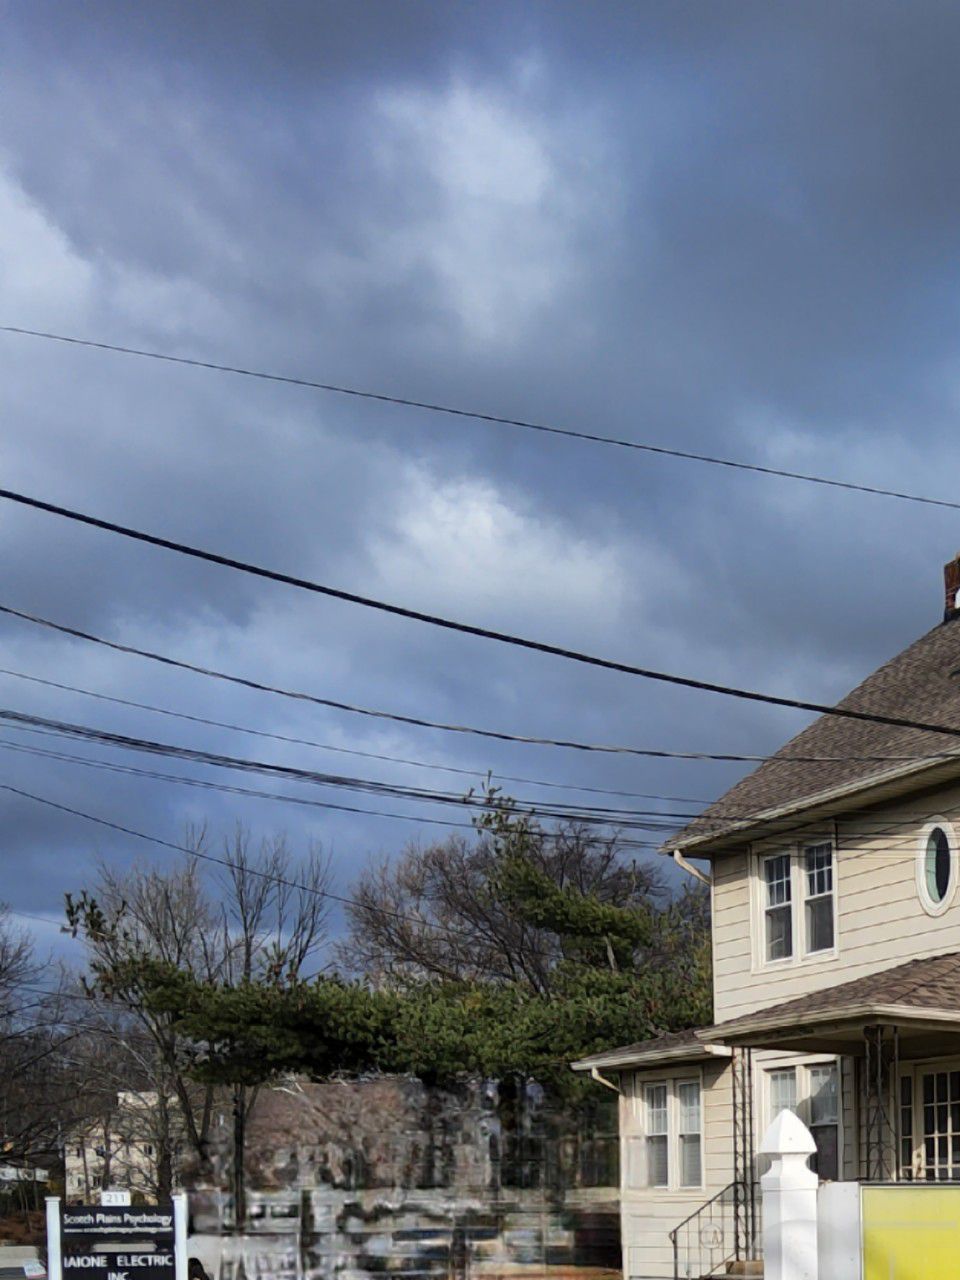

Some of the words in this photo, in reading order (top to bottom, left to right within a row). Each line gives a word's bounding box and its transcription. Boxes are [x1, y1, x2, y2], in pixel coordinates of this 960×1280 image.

[105, 1193, 125, 1203] 211
[64, 1213, 94, 1224] Scotch
[96, 1213, 122, 1224] Plains
[123, 1212, 172, 1226] Psychology
[117, 1255, 173, 1266] ELECTRIC
